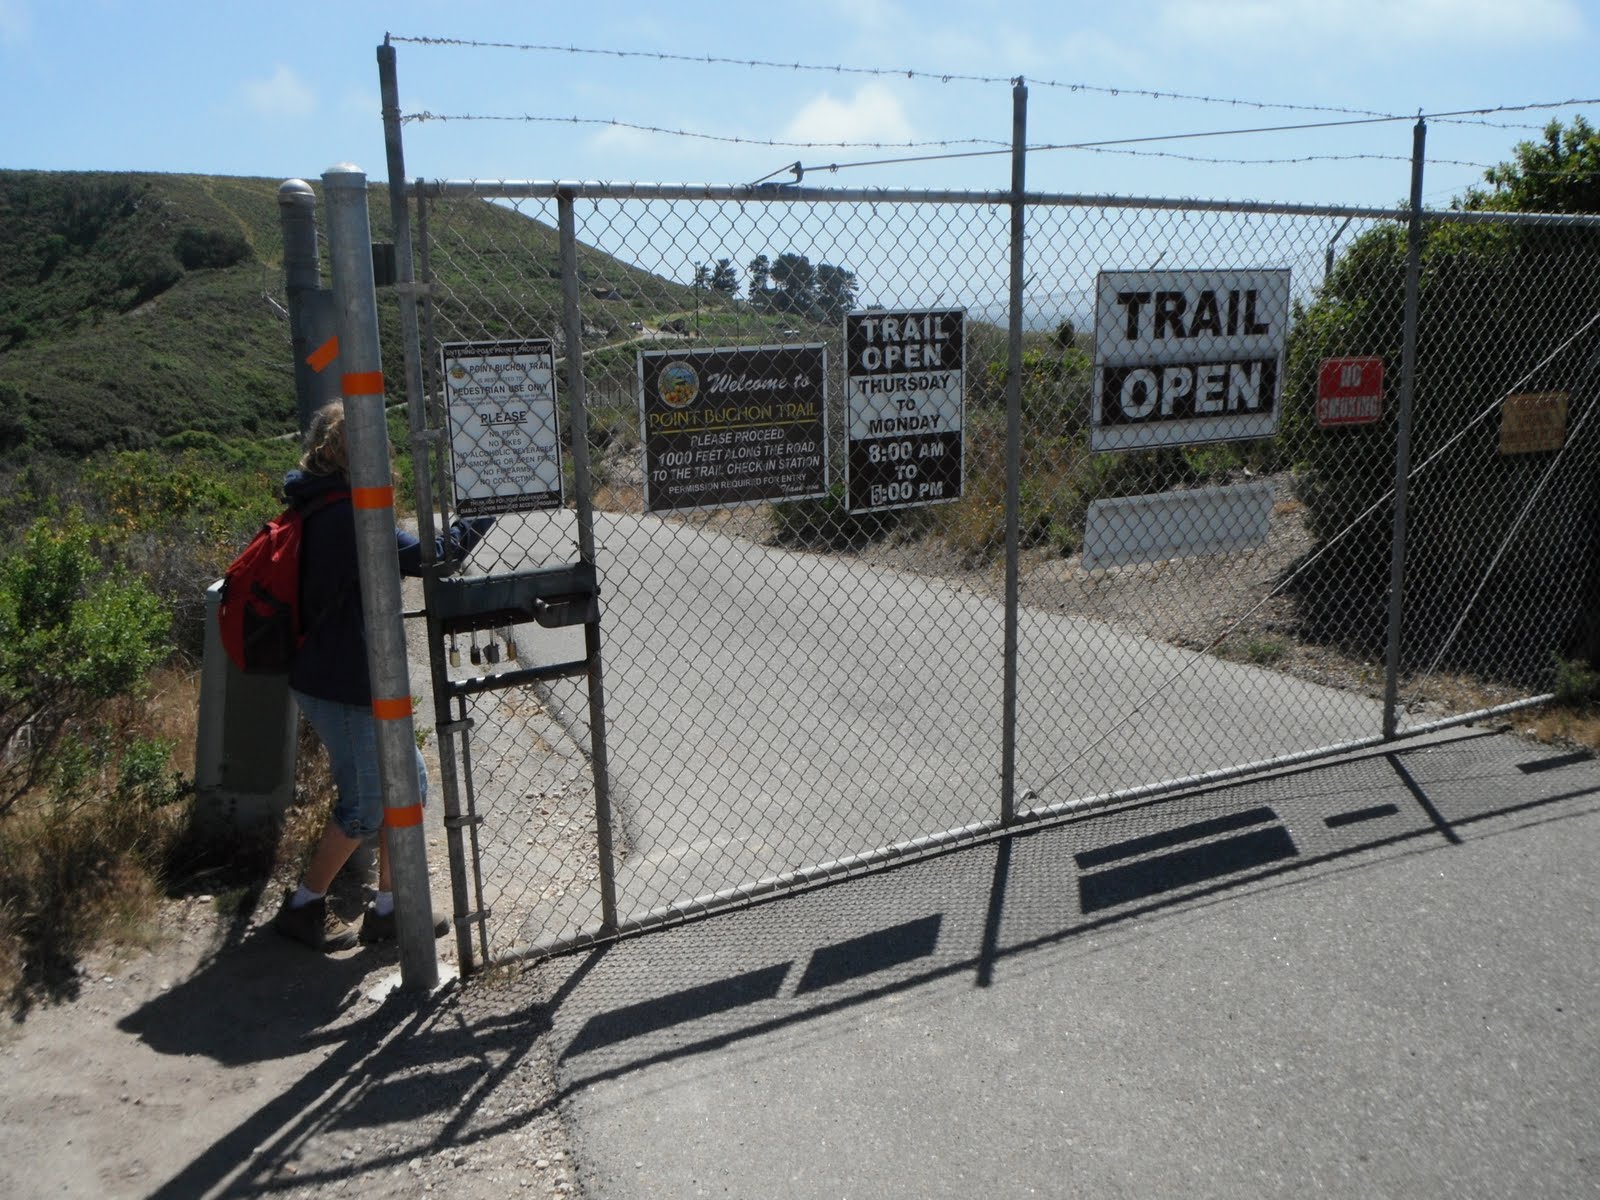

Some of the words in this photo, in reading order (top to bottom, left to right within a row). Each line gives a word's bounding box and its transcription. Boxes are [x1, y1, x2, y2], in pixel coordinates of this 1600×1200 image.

[1117, 289, 1269, 340] TRAIL
[861, 316, 949, 342] TRAIL
[469, 365, 493, 373] POINT
[495, 363, 527, 372] BUCHON
[529, 361, 550, 370] TRAIL
[862, 343, 942, 371] OPEN
[707, 372, 788, 393] Welcome
[794, 373, 810, 388] to
[859, 374, 950, 394] THURSDAY
[1341, 365, 1362, 388] NO
[453, 385, 506, 396] PEDESTRIAN
[508, 384, 524, 393] USE
[527, 383, 547, 392] ONLY
[1120, 361, 1262, 418] OPEN
[650, 410, 700, 428] POINT
[704, 405, 772, 424] BUCHON
[776, 402, 819, 418] TRAIL
[896, 399, 916, 411] TO
[1320, 395, 1378, 419] SMOKING
[480, 411, 527, 423] PLEASE
[869, 414, 940, 434] MONDAY
[502, 429, 520, 437] PETS
[691, 433, 732, 447] PLEASE
[735, 428, 785, 443] PROCEED
[470, 449, 511, 458] ALCOHOLIC
[513, 445, 554, 454] BEVERAGES
[658, 451, 692, 467] 1000
[695, 449, 723, 463] FEET
[724, 446, 761, 460] ALONG
[764, 444, 784, 456] THE
[786, 441, 815, 454] ROAD
[868, 441, 913, 463] 8:00
[918, 442, 944, 458] AM
[456, 461, 467, 469] NO
[496, 466, 531, 474] FIREARMS
[653, 470, 667, 482] TO
[671, 467, 691, 480] THE
[695, 465, 724, 477] TRAIL
[727, 461, 764, 475] CHECK
[766, 459, 777, 470] IN
[778, 456, 820, 469] STATION
[895, 464, 918, 480] TO
[492, 475, 536, 485] COLLECTING
[668, 482, 719, 495] PERMISSION
[720, 477, 762, 489] REQUIRED
[763, 475, 780, 485] FOR
[781, 473, 807, 482] ENTRY
[871, 481, 913, 505] 5:00
[919, 481, 943, 497] PM
